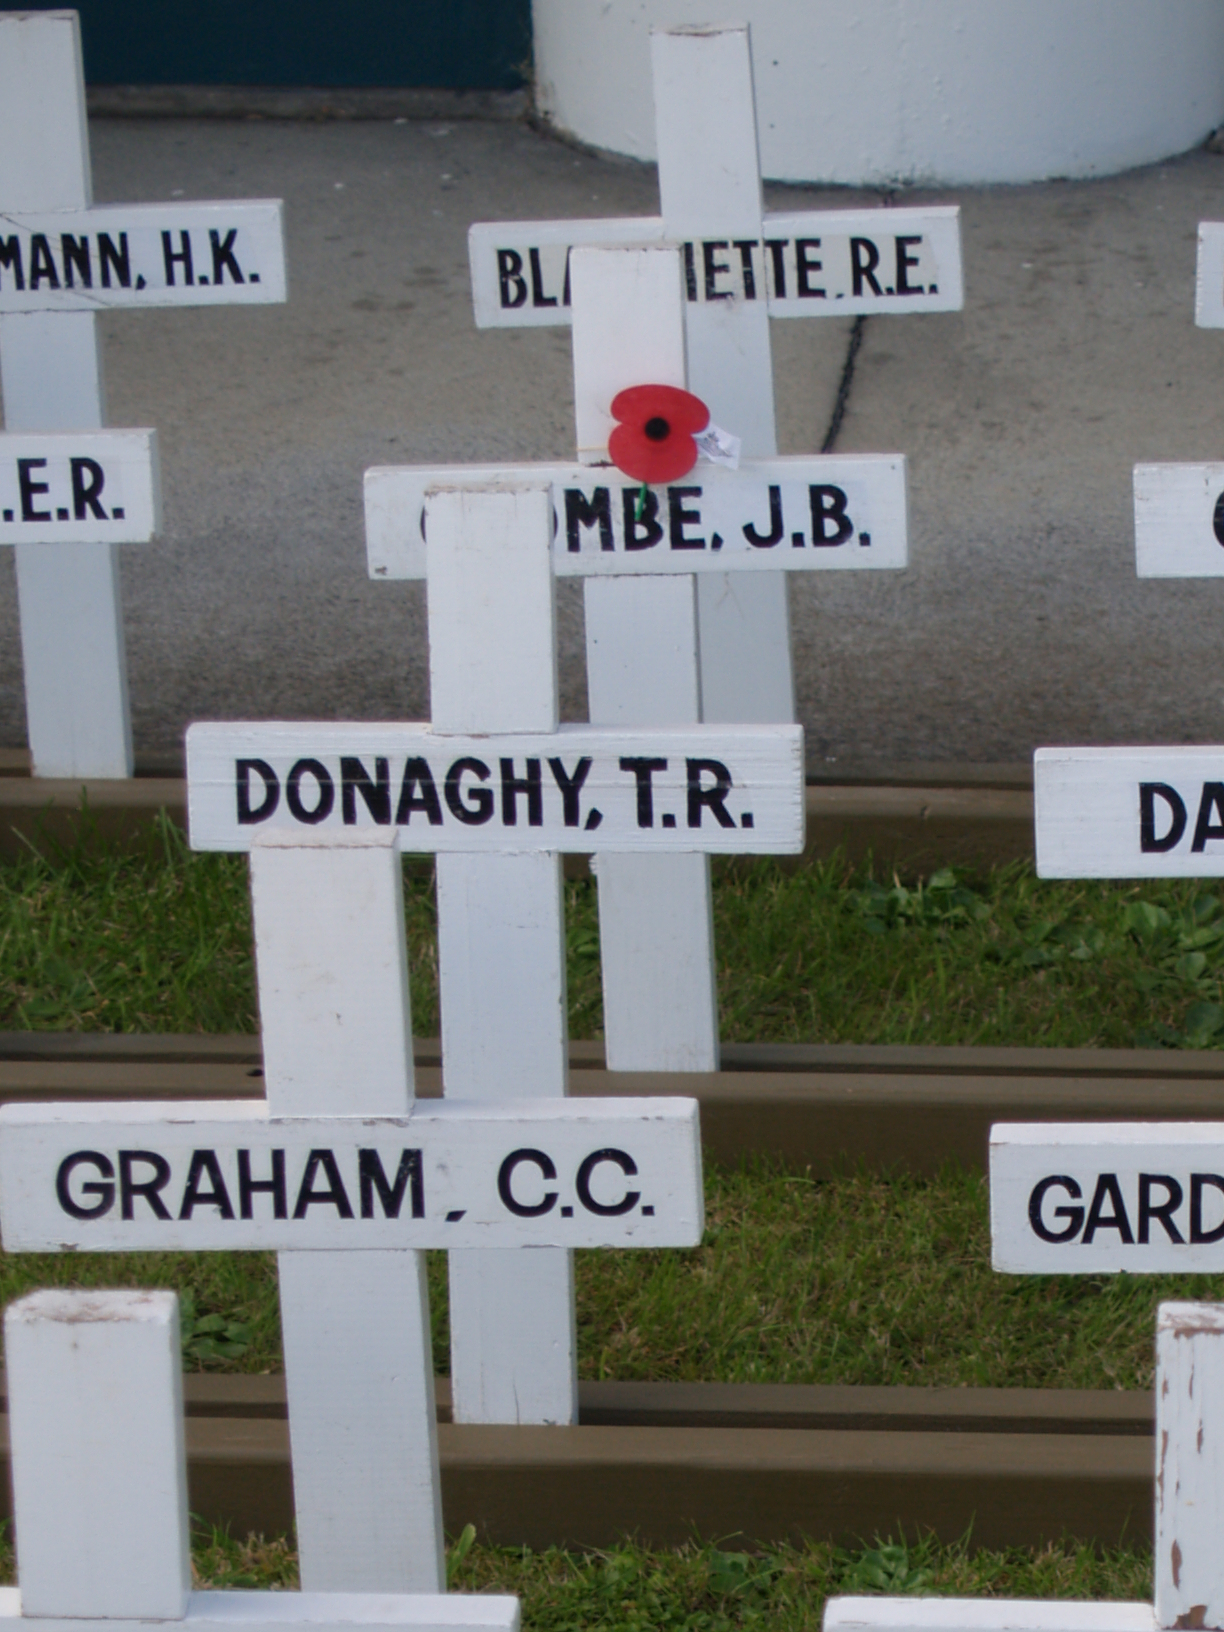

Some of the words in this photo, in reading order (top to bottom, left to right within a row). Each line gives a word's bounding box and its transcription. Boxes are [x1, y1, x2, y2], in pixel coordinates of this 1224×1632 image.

[160, 228, 260, 287] H.K.
[741, 483, 871, 549] J.B.
[234, 755, 604, 831] DONAGHY,
[617, 755, 755, 829] T.R.
[496, 1146, 655, 1219] C.C.
